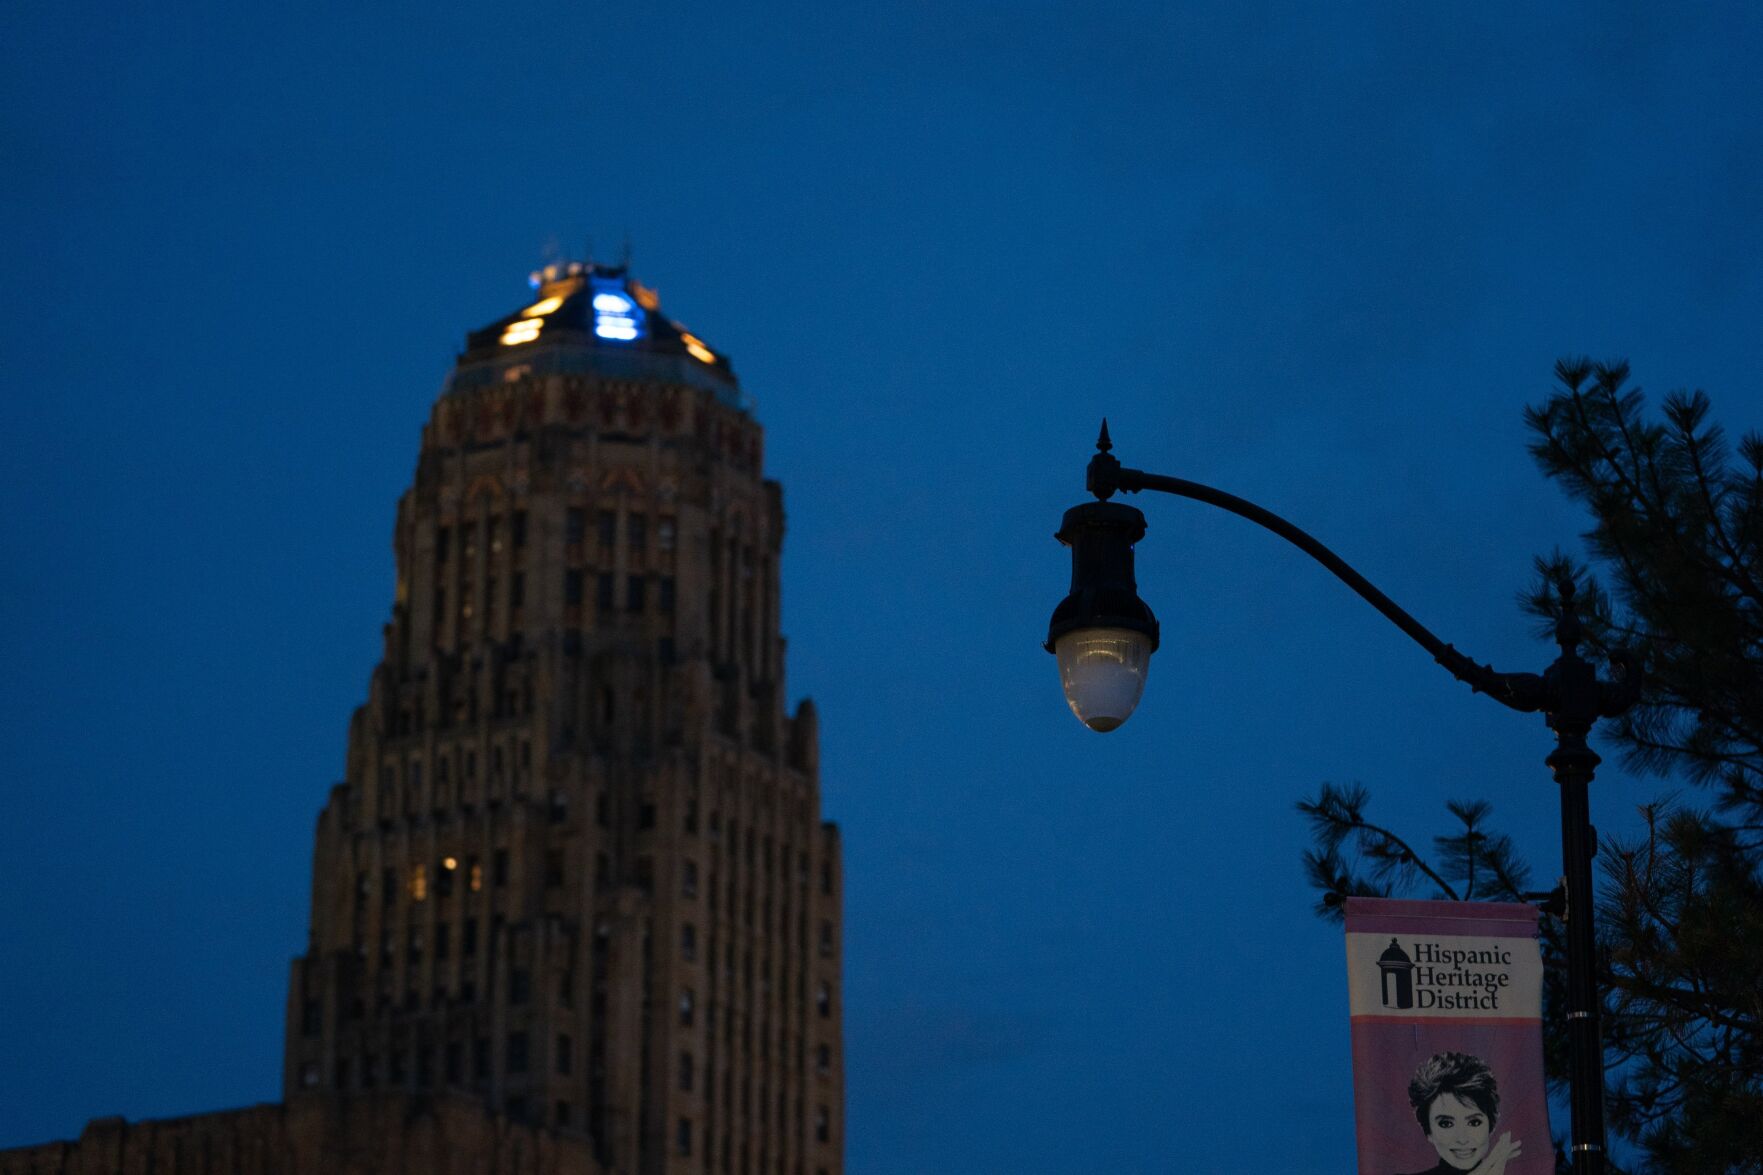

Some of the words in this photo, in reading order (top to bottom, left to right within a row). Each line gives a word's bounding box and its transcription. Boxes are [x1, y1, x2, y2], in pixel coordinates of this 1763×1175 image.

[1414, 943, 1511, 970] Hispanic
[1415, 967, 1509, 993] Heritage
[1416, 989, 1498, 1010] District
